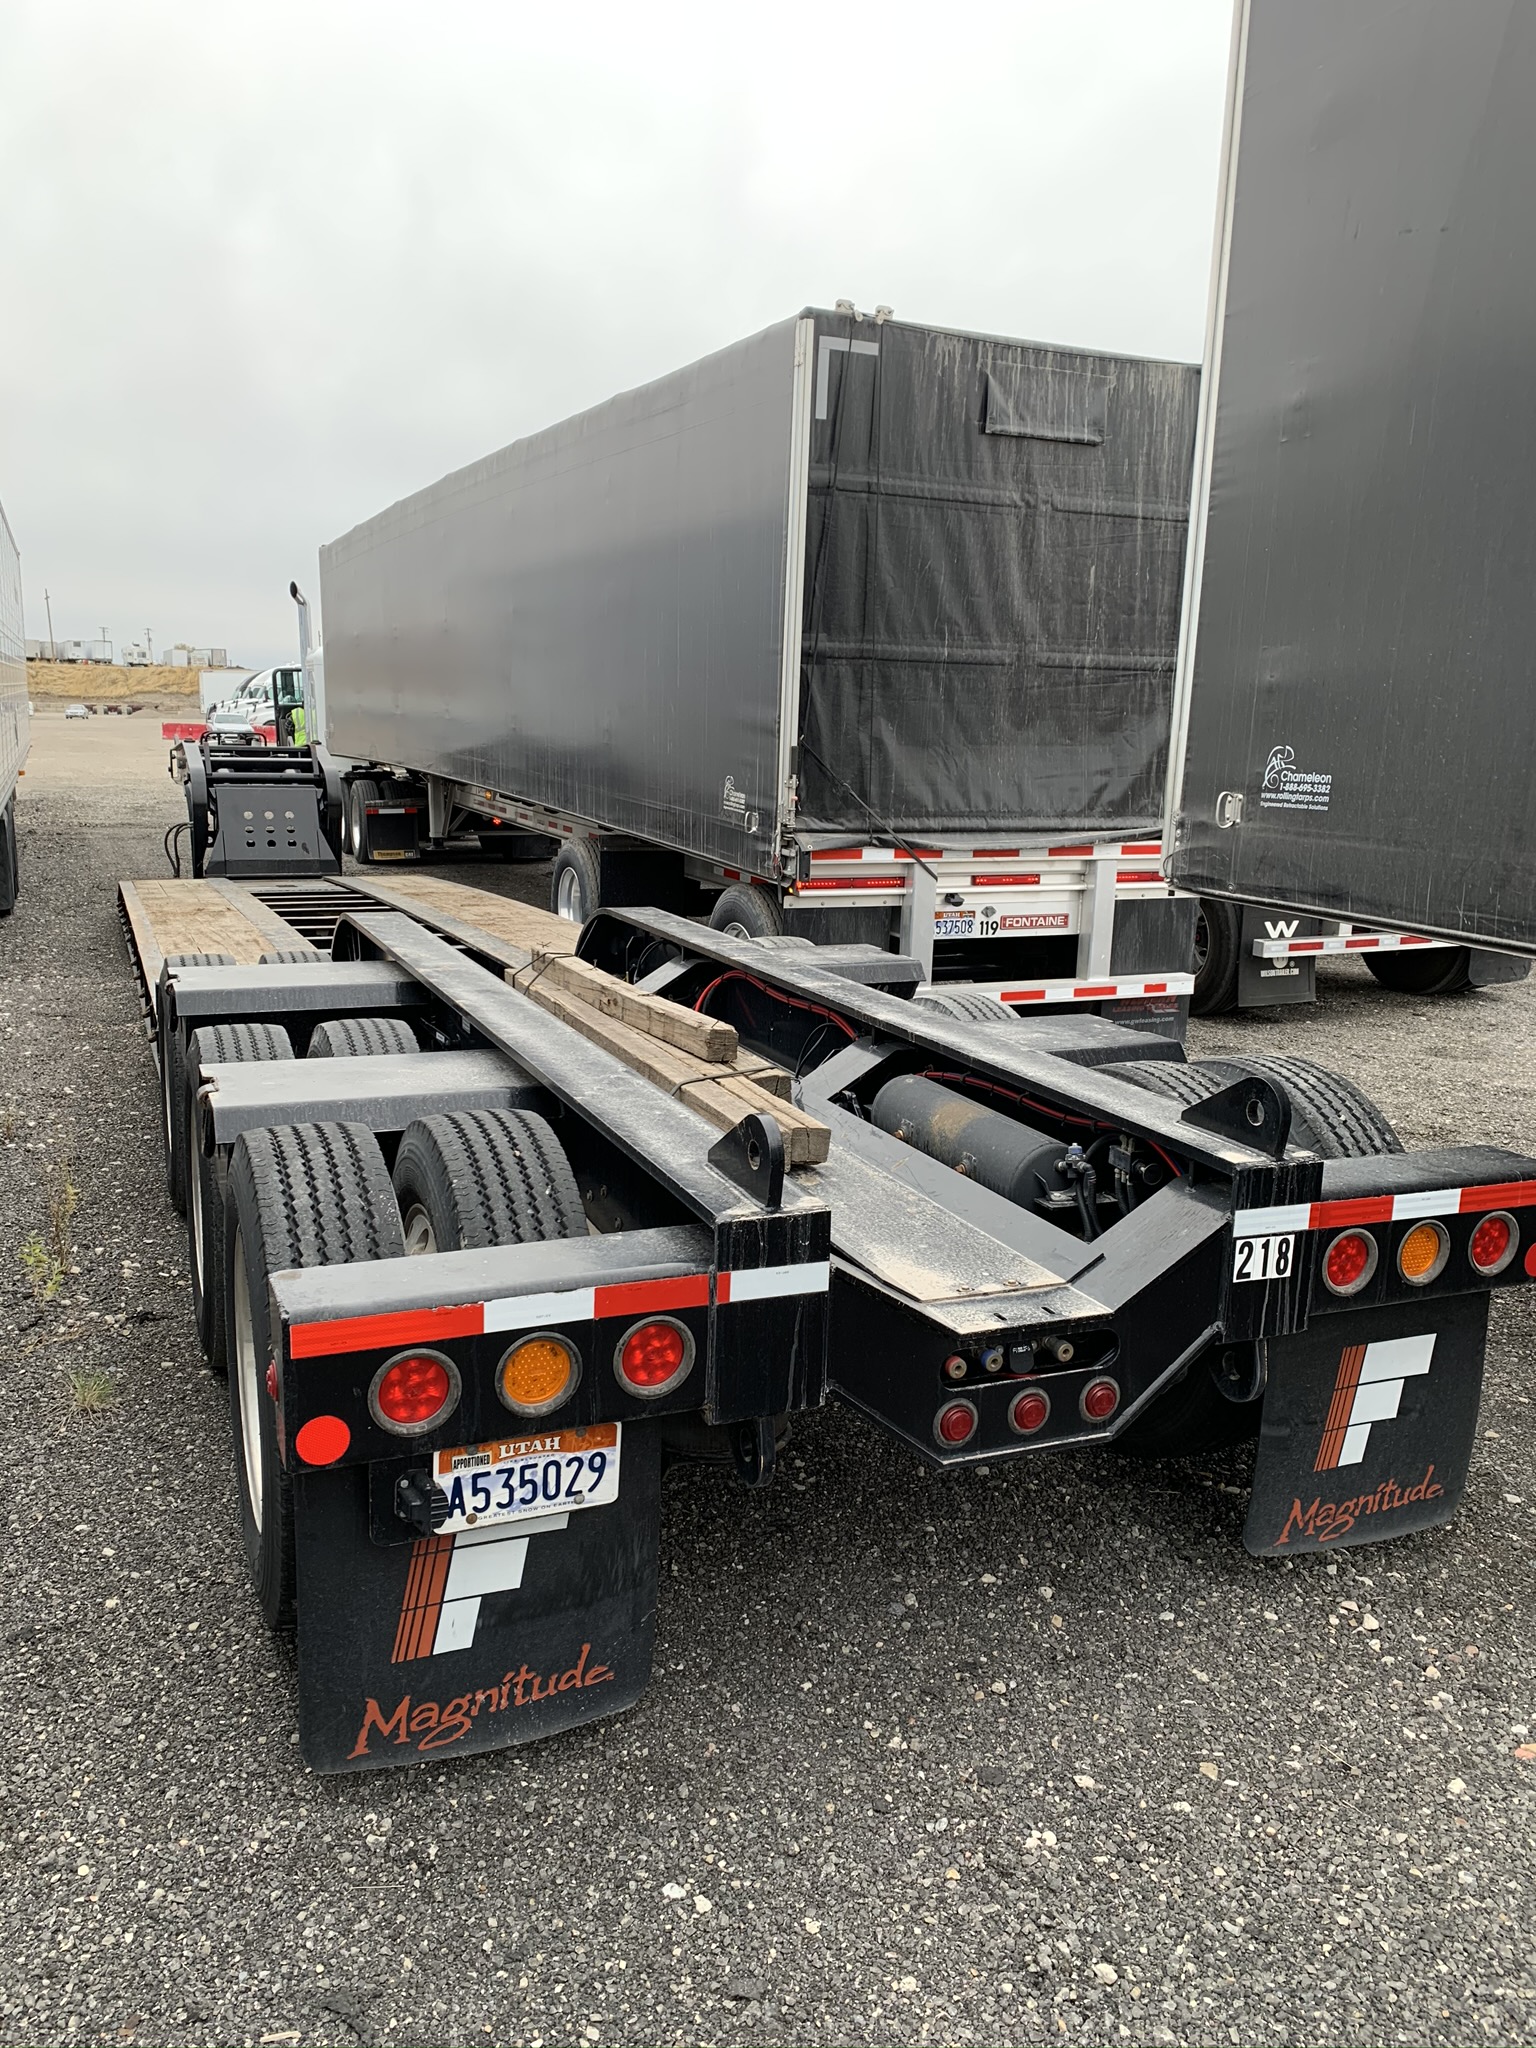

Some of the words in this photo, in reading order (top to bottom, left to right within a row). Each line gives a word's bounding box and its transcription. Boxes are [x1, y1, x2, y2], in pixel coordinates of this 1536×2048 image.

[1281, 771, 1332, 783] Chameleon
[1280, 783, 1331, 793] 1-888-695-3382
[1261, 793, 1330, 802] www.rollingtarps.com
[1308, 803, 1329, 811] Solutions
[935, 919, 974, 935] 537508
[979, 920, 999, 936] 119
[1005, 916, 1066, 927] FONTAINE
[1235, 1236, 1291, 1281] 218
[498, 1436, 561, 1459] UTAH
[452, 1453, 490, 1471] APPORTIONED
[448, 1451, 607, 1519] A535029
[518, 1505, 539, 1514] SNOW
[1273, 1464, 1443, 1547] Magnitude
[347, 1642, 612, 1761] Magnitude
